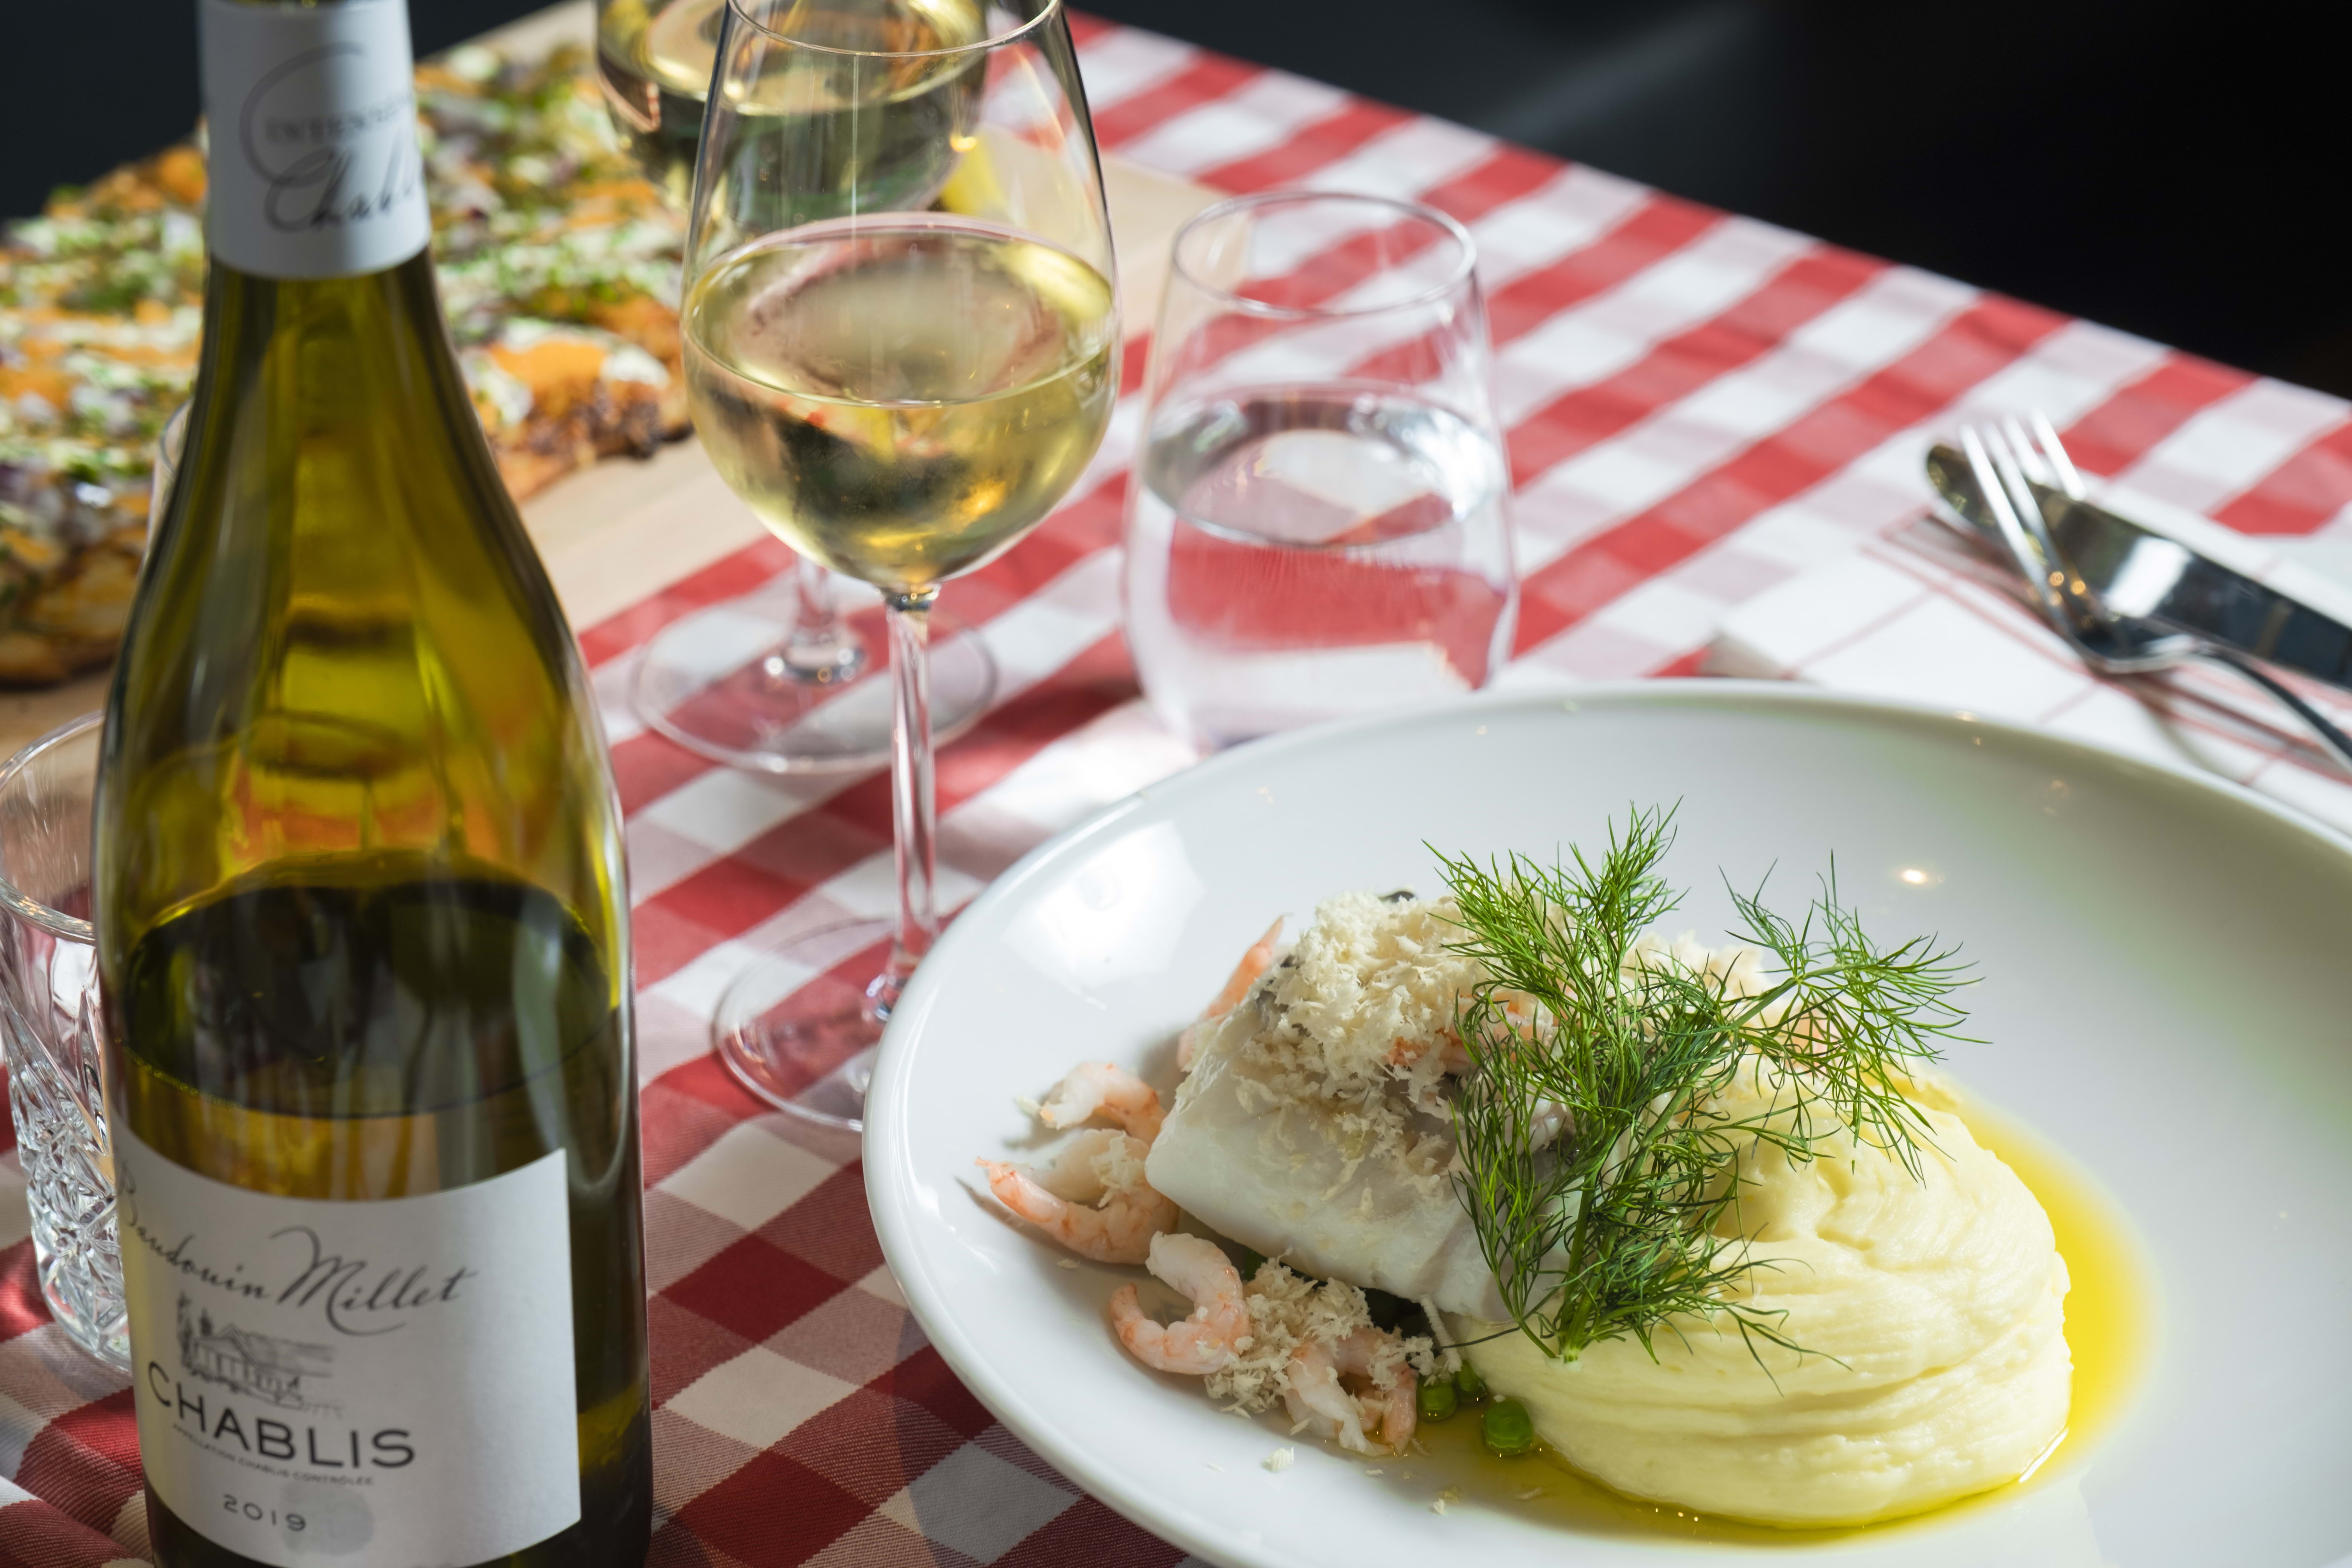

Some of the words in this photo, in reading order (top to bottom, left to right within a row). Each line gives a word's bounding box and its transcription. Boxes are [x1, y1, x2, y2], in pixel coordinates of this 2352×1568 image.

[268, 1225, 479, 1337] Millet
[148, 1361, 416, 1469] CHABLIS
[223, 1494, 307, 1531] 2019
